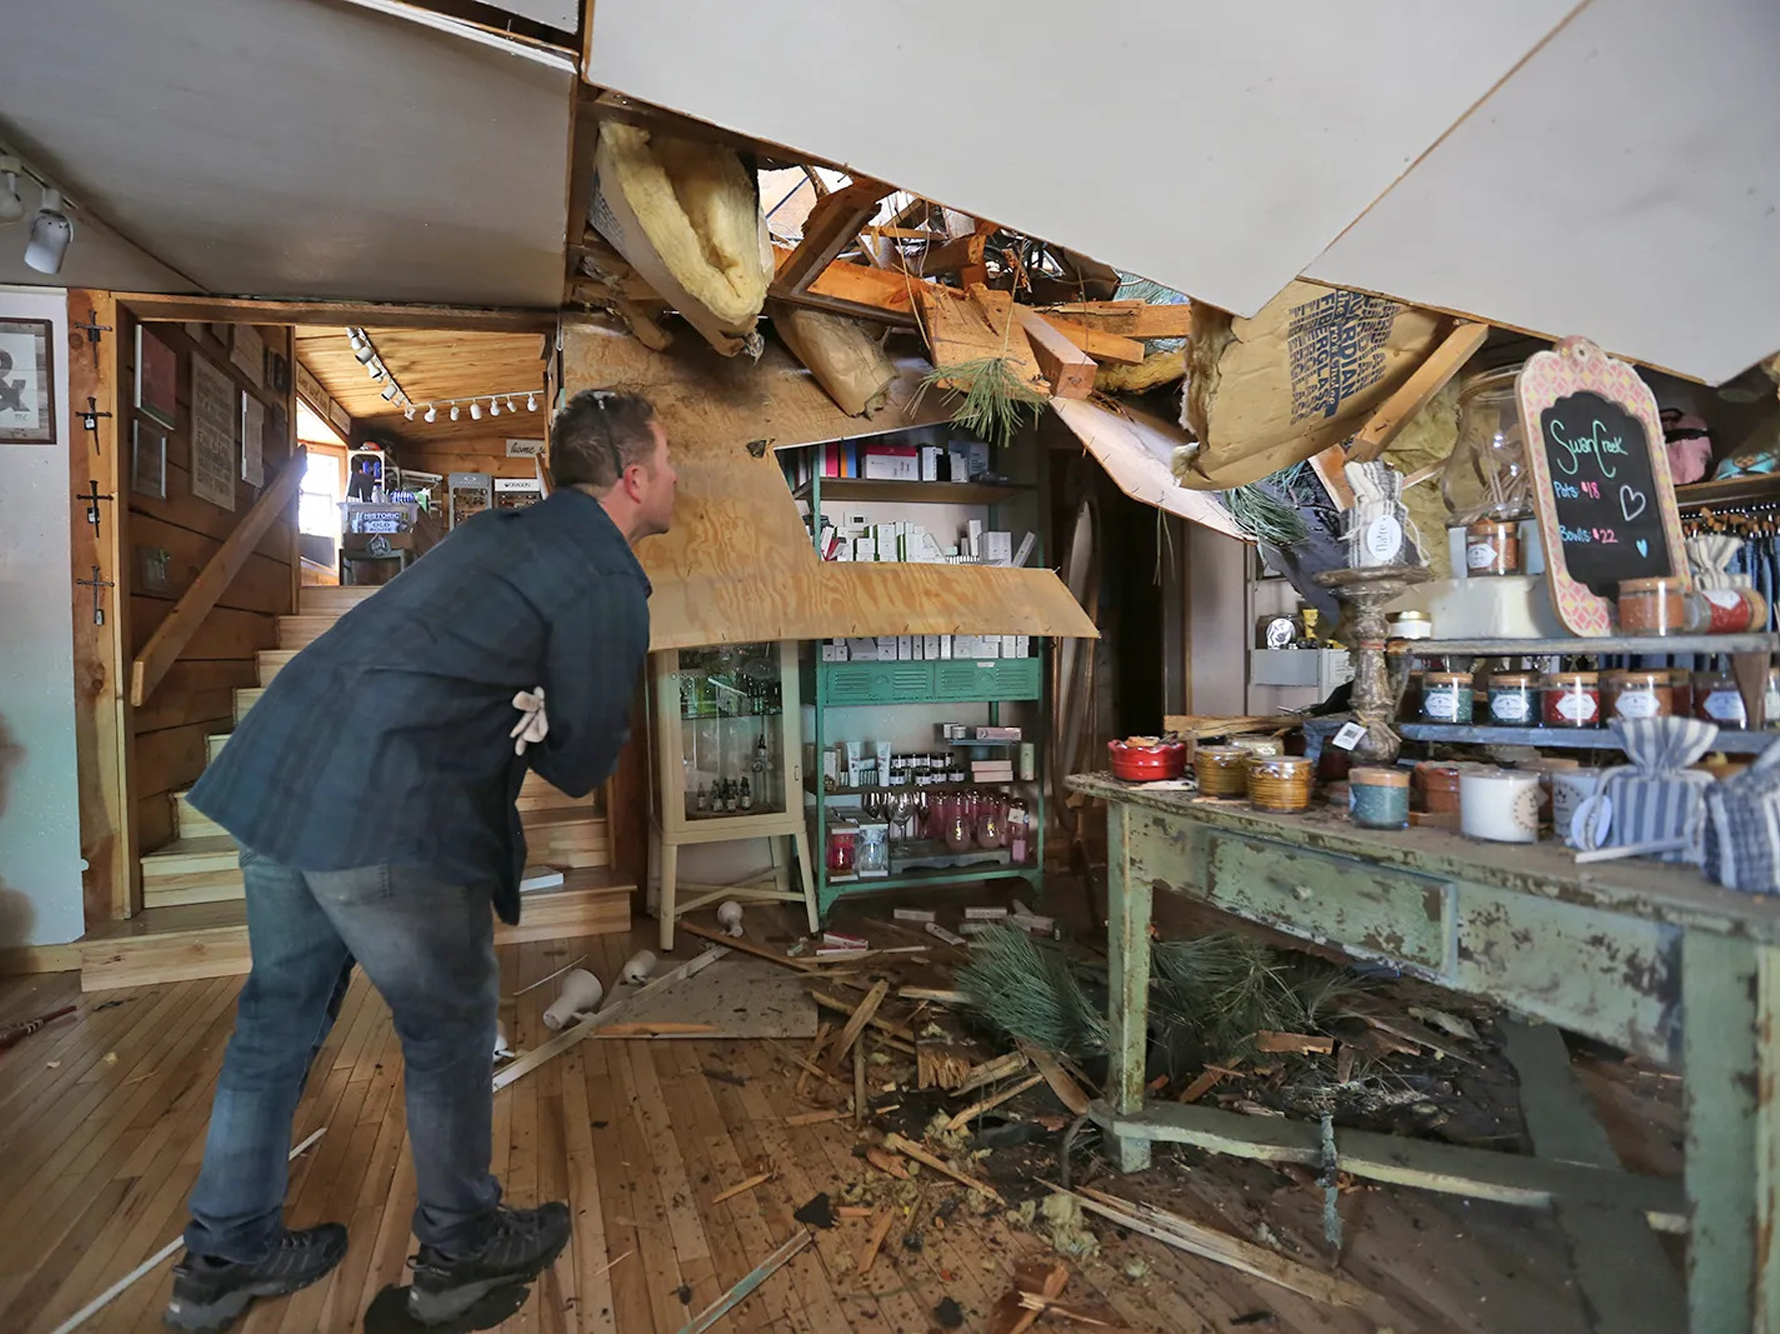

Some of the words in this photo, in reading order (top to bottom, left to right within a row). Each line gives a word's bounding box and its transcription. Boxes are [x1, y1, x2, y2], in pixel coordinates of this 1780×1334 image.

[1335, 290, 1351, 316] the
[1314, 292, 1336, 412] FIBERGLASS
[364, 512, 400, 520] HISTORIC
